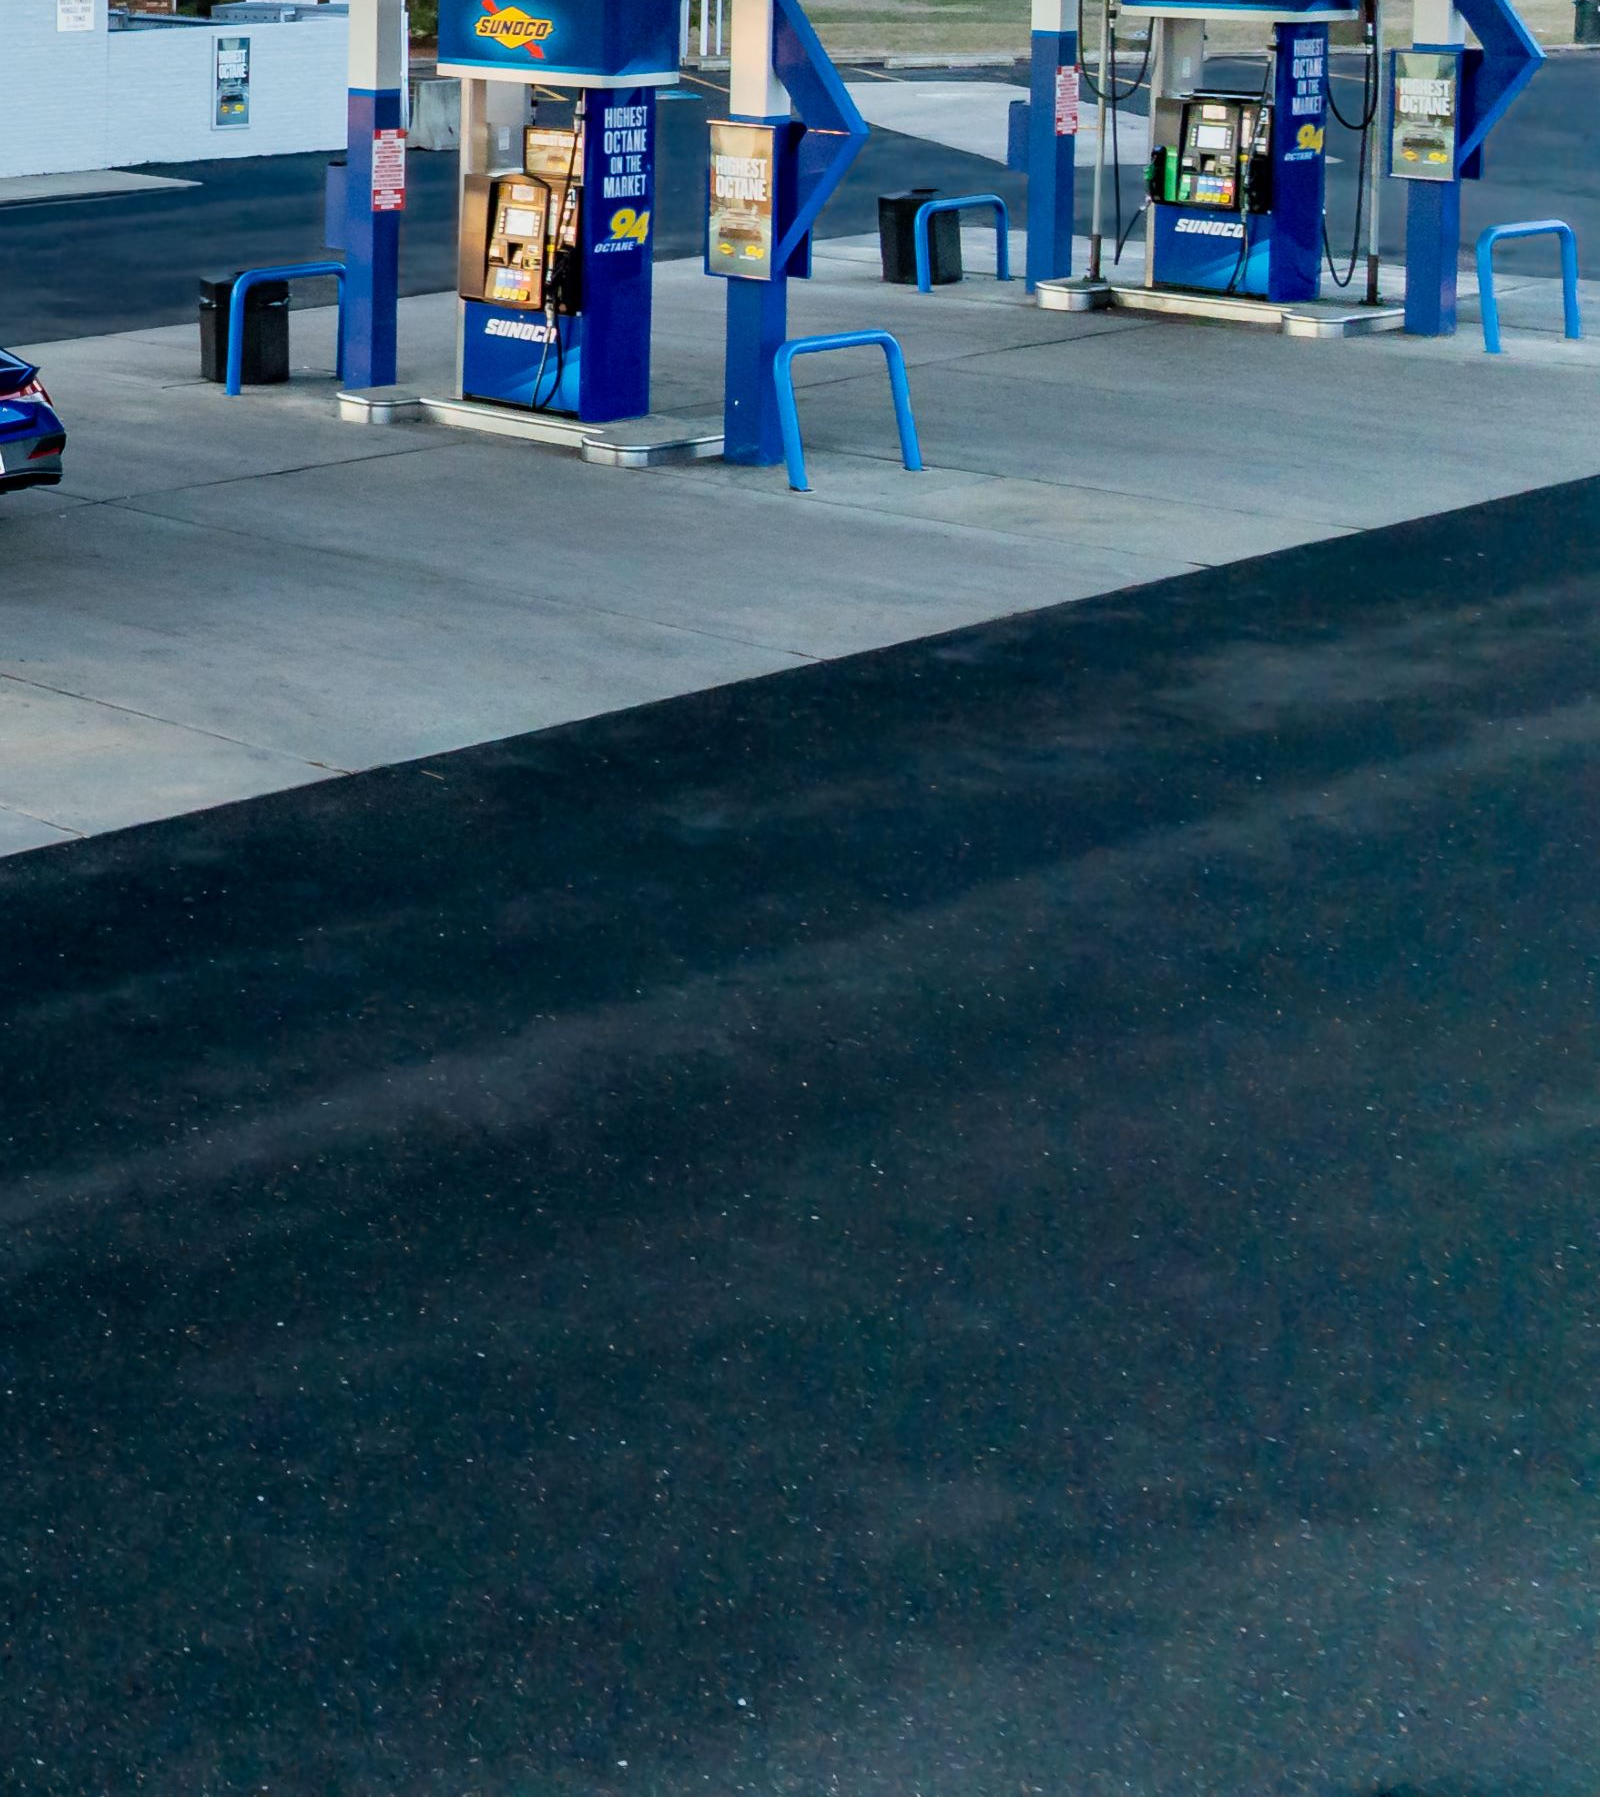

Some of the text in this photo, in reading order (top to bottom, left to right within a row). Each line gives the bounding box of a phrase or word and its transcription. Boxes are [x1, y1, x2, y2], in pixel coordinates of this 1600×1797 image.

[479, 19, 549, 38] SUNOCO
[1292, 58, 1323, 78] OCTANE
[1400, 77, 1451, 97] HIGHEST
[1400, 94, 1451, 116] OCTANE
[604, 106, 648, 129] HIGHEST
[604, 128, 648, 154] OCTANE
[1297, 124, 1325, 155] 94
[610, 155, 642, 175] ON THE
[715, 155, 767, 179] HIGHEST
[604, 174, 646, 199] MARKET
[715, 175, 767, 202] OCTANE
[610, 209, 650, 244] 94
[1174, 218, 1245, 239] SUNOCO
[594, 241, 634, 253] OCTANE
